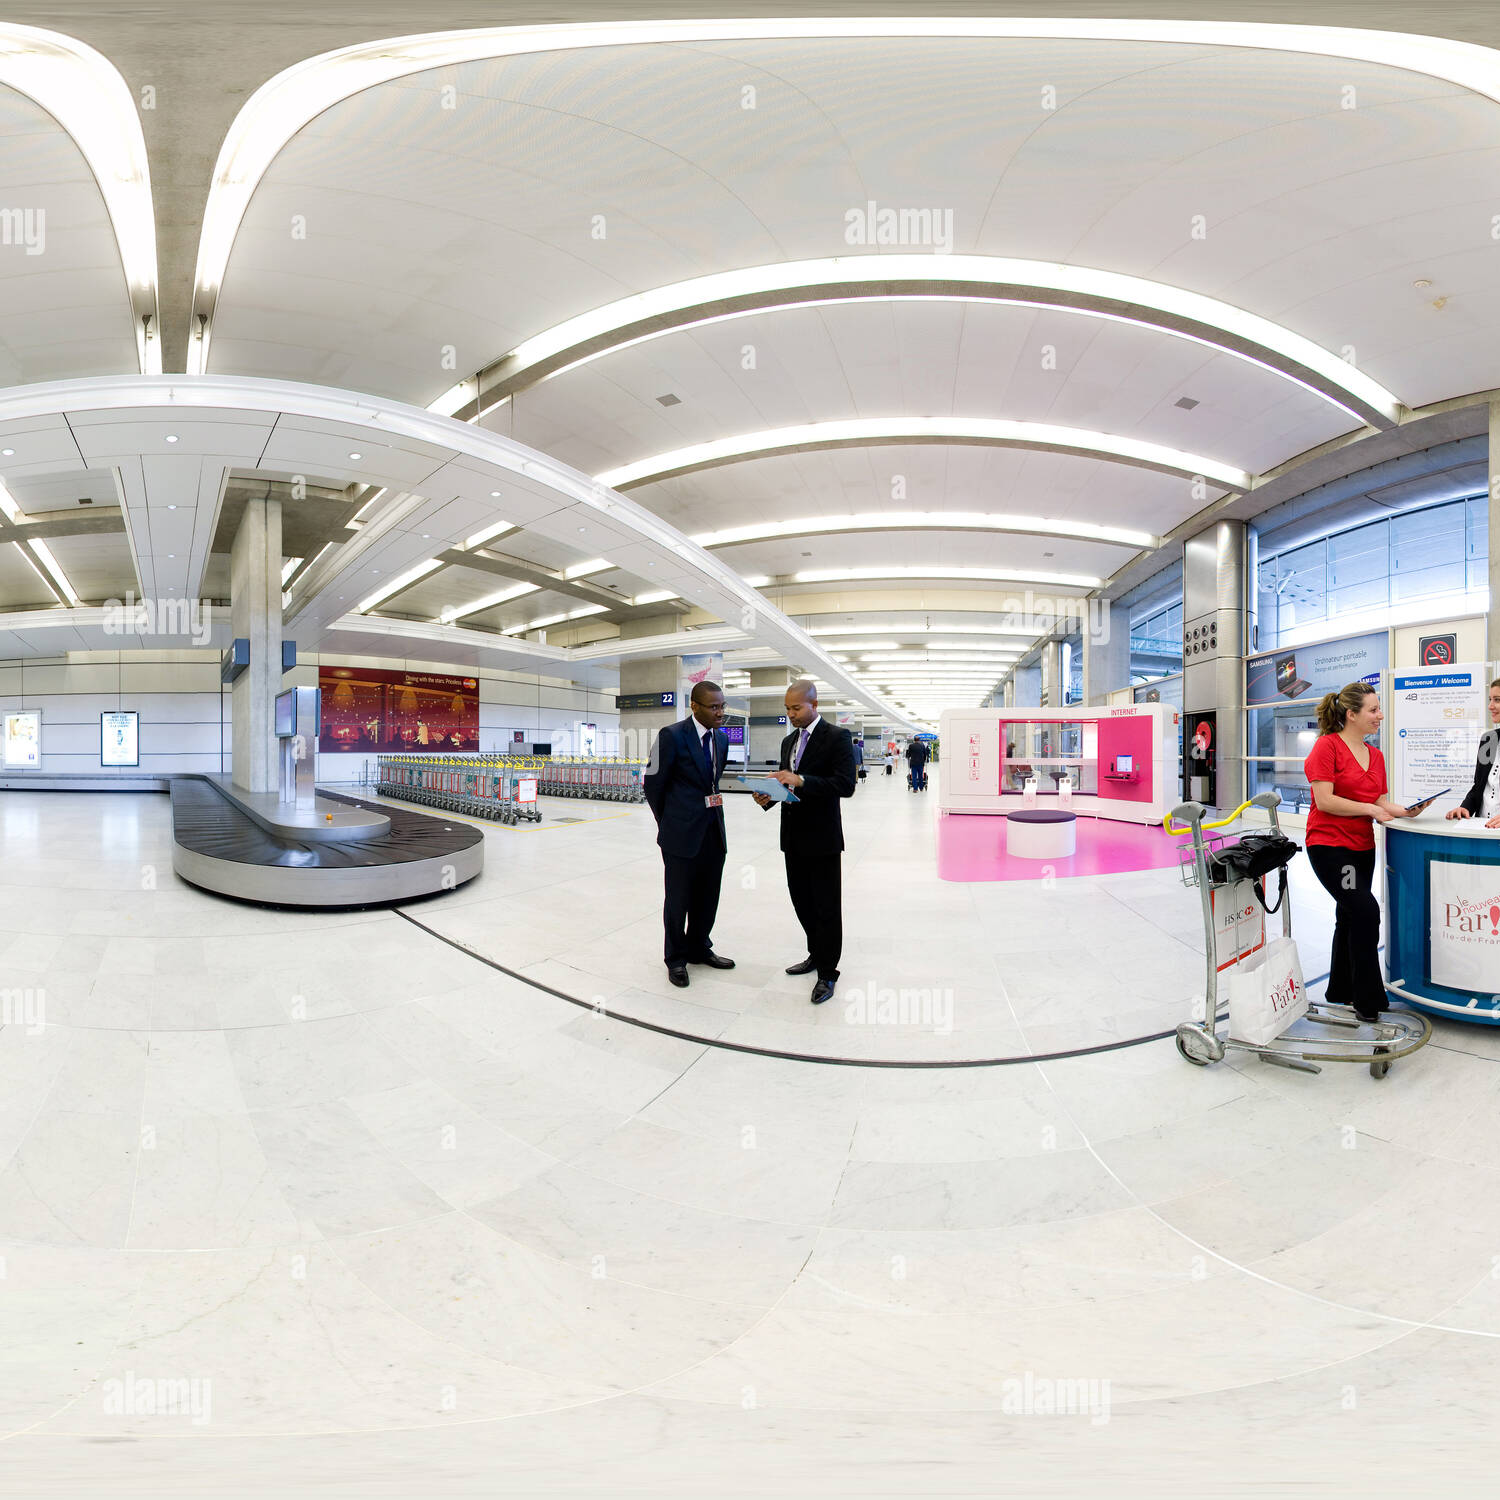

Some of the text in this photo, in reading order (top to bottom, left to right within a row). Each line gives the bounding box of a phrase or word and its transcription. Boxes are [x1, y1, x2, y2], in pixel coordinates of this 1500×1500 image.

[1250, 658, 1272, 668] SAMSUNG
[1315, 650, 1368, 666] Ordinateur portable
[663, 694, 673, 703] 22
[1111, 708, 1137, 716] INTERNET
[1456, 896, 1469, 907] le
